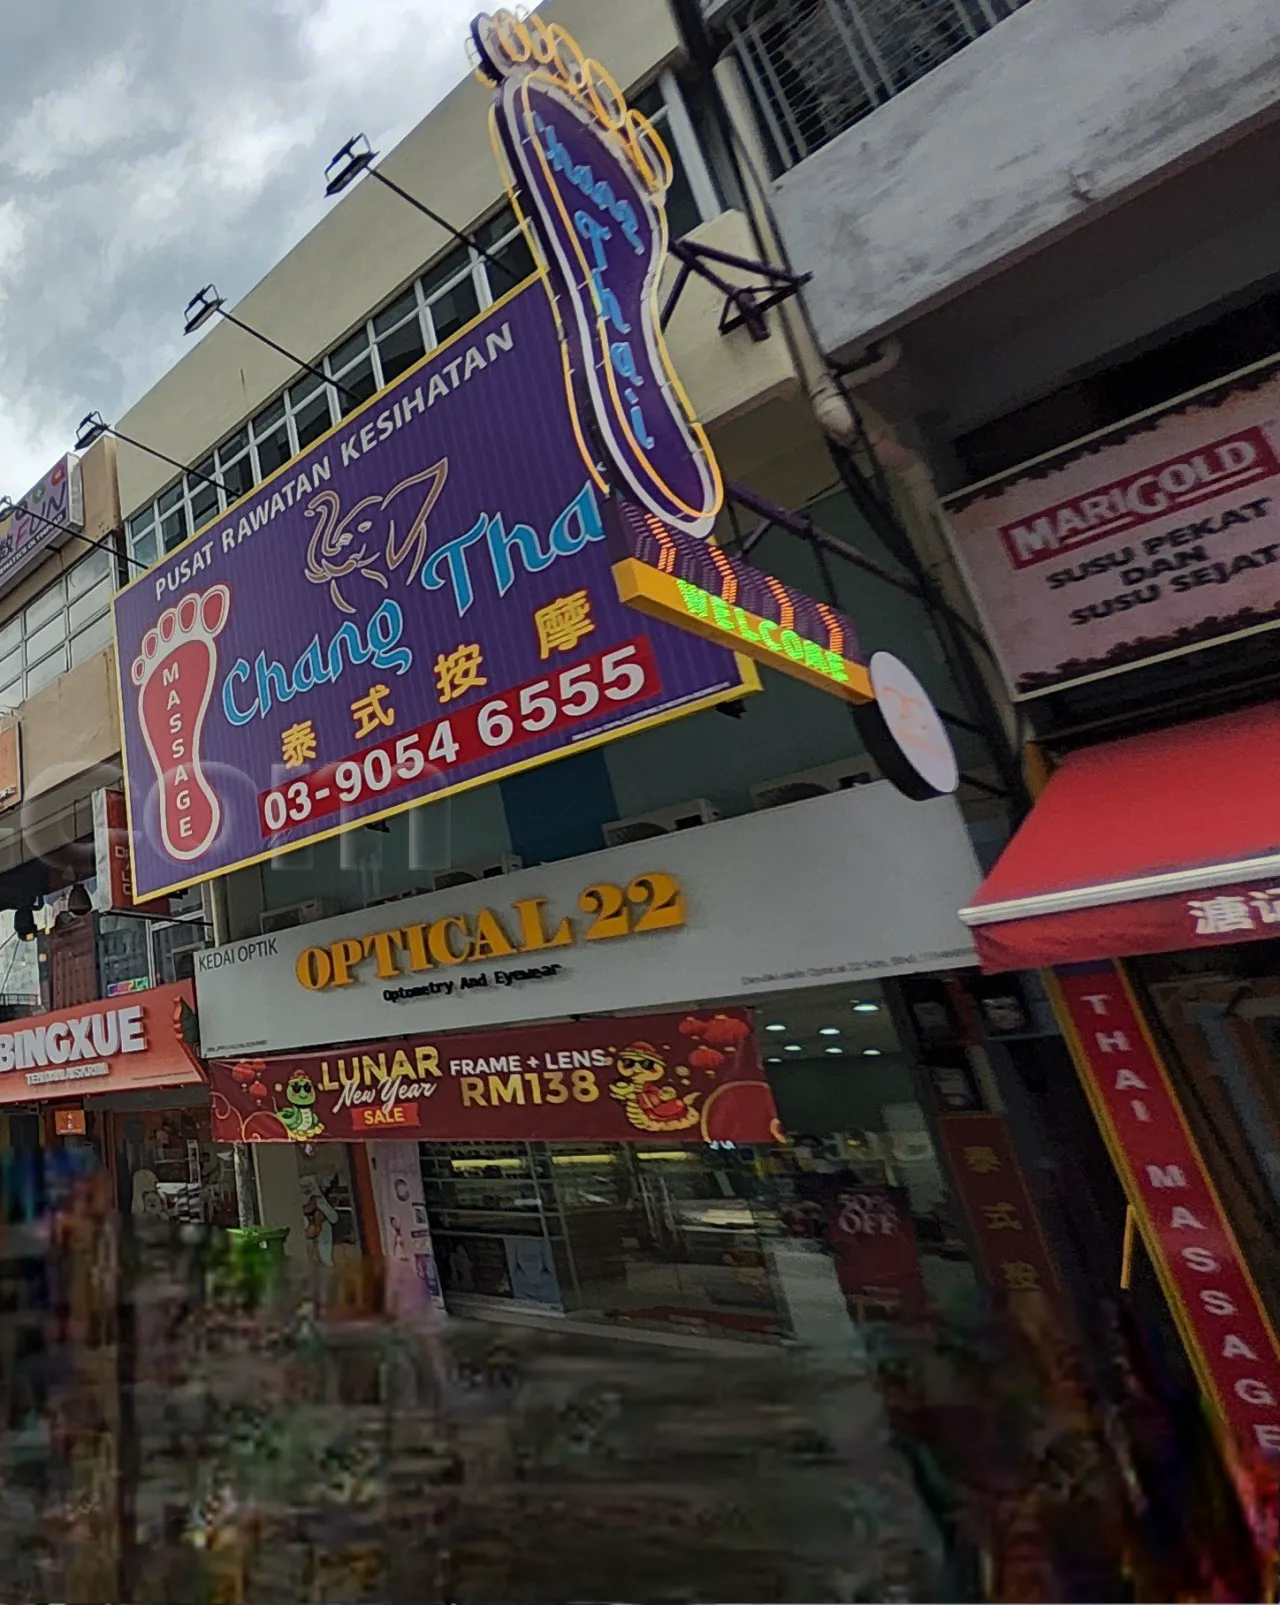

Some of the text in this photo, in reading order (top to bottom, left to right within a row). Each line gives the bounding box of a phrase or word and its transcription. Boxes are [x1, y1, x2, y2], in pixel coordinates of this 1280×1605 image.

[154, 322, 516, 601] PUSAT RAWATAN KESIHATAN
[1007, 440, 1258, 561] MARIGOLD
[1045, 497, 1272, 590] SUSU PEKAT
[1120, 544, 1210, 587] DAN
[222, 598, 413, 727] Chang
[420, 479, 607, 618] Tha
[676, 579, 849, 682] WELCOME
[1069, 583, 1161, 626] SUSU
[281, 589, 596, 770] 泰式按摩
[162, 661, 194, 839] MASSAGE
[263, 719, 461, 831] 03-9054
[476, 644, 646, 748] 6555
[197, 937, 279, 972] KEDAI OPTIK
[294, 872, 687, 992] OPTICAL 22
[382, 962, 562, 1004] Optometry And Eyewear
[321, 1045, 443, 1092] LUNAR
[332, 1075, 438, 1114] New Year
[449, 1047, 605, 1076] FRAME + LENS
[461, 1069, 600, 1108] RM138
[363, 1109, 406, 1126] SALE
[1080, 994, 1280, 1452] THAI MASSAGE
